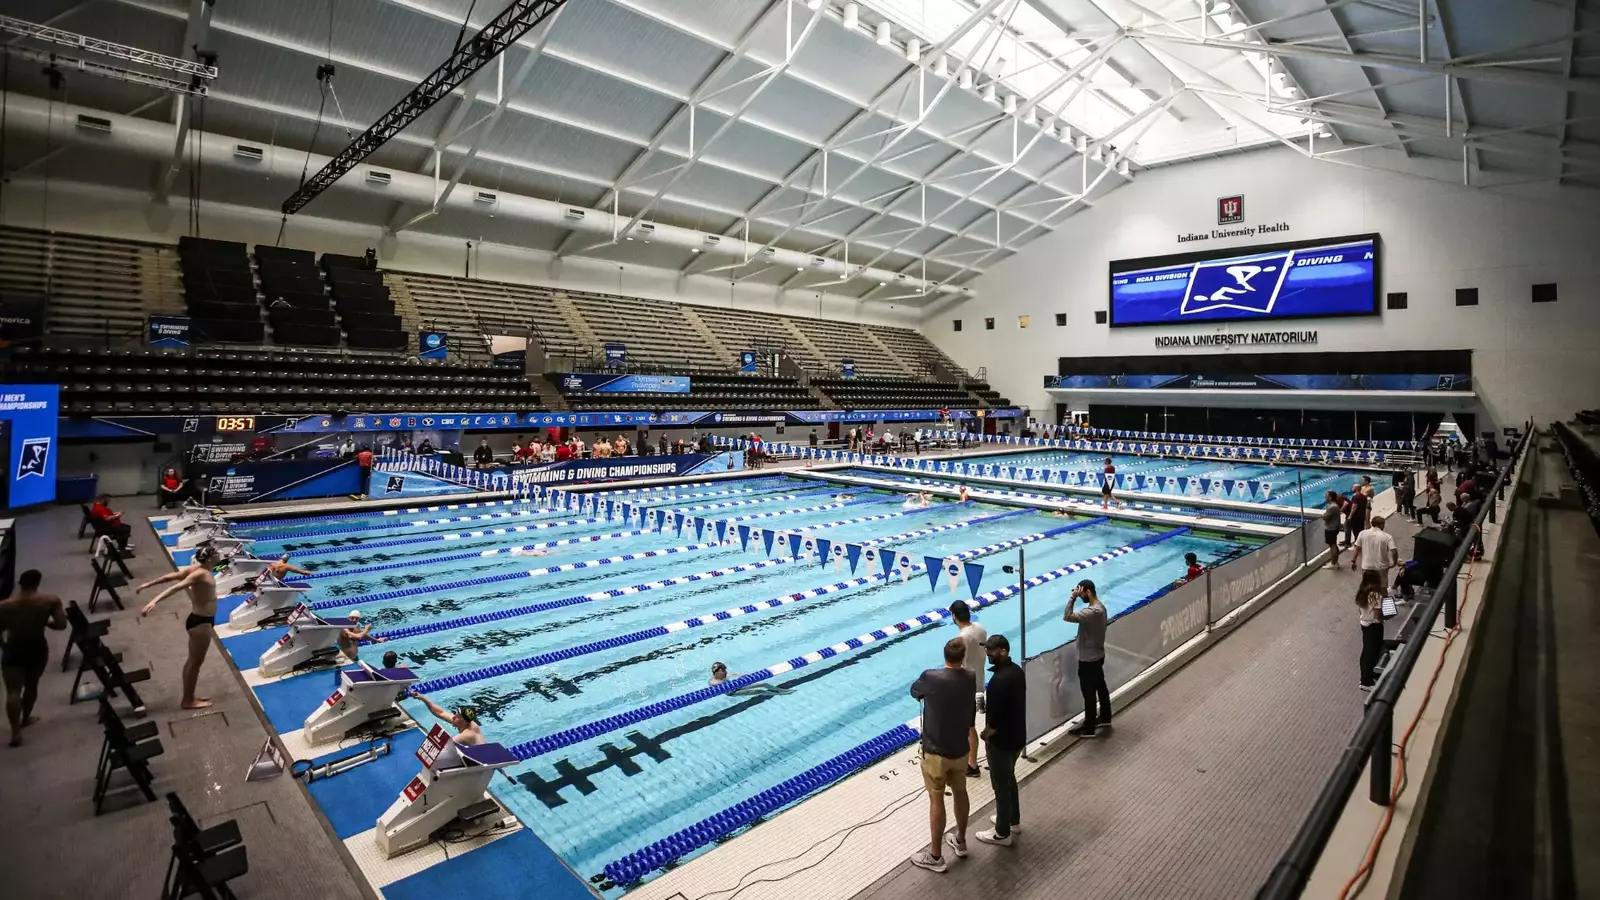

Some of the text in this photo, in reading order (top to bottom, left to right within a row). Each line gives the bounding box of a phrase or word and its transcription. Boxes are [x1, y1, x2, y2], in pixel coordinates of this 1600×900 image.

[1177, 222, 1290, 243] Indiana University Health
[1297, 255, 1343, 267] DIVING
[1155, 272, 1188, 281] DIVISION
[1155, 331, 1318, 346] INDIANA UNIVERSITY NATATORIUM
[4, 394, 26, 402] MEN'S
[218, 418, 253, 430] 03:57
[567, 469, 575, 480] &
[576, 467, 607, 480] DIVING
[609, 463, 676, 477] CHAMPIONSHIPS
[288, 641, 294, 649] 3
[340, 701, 346, 711] 2
[422, 794, 428, 805] 1
